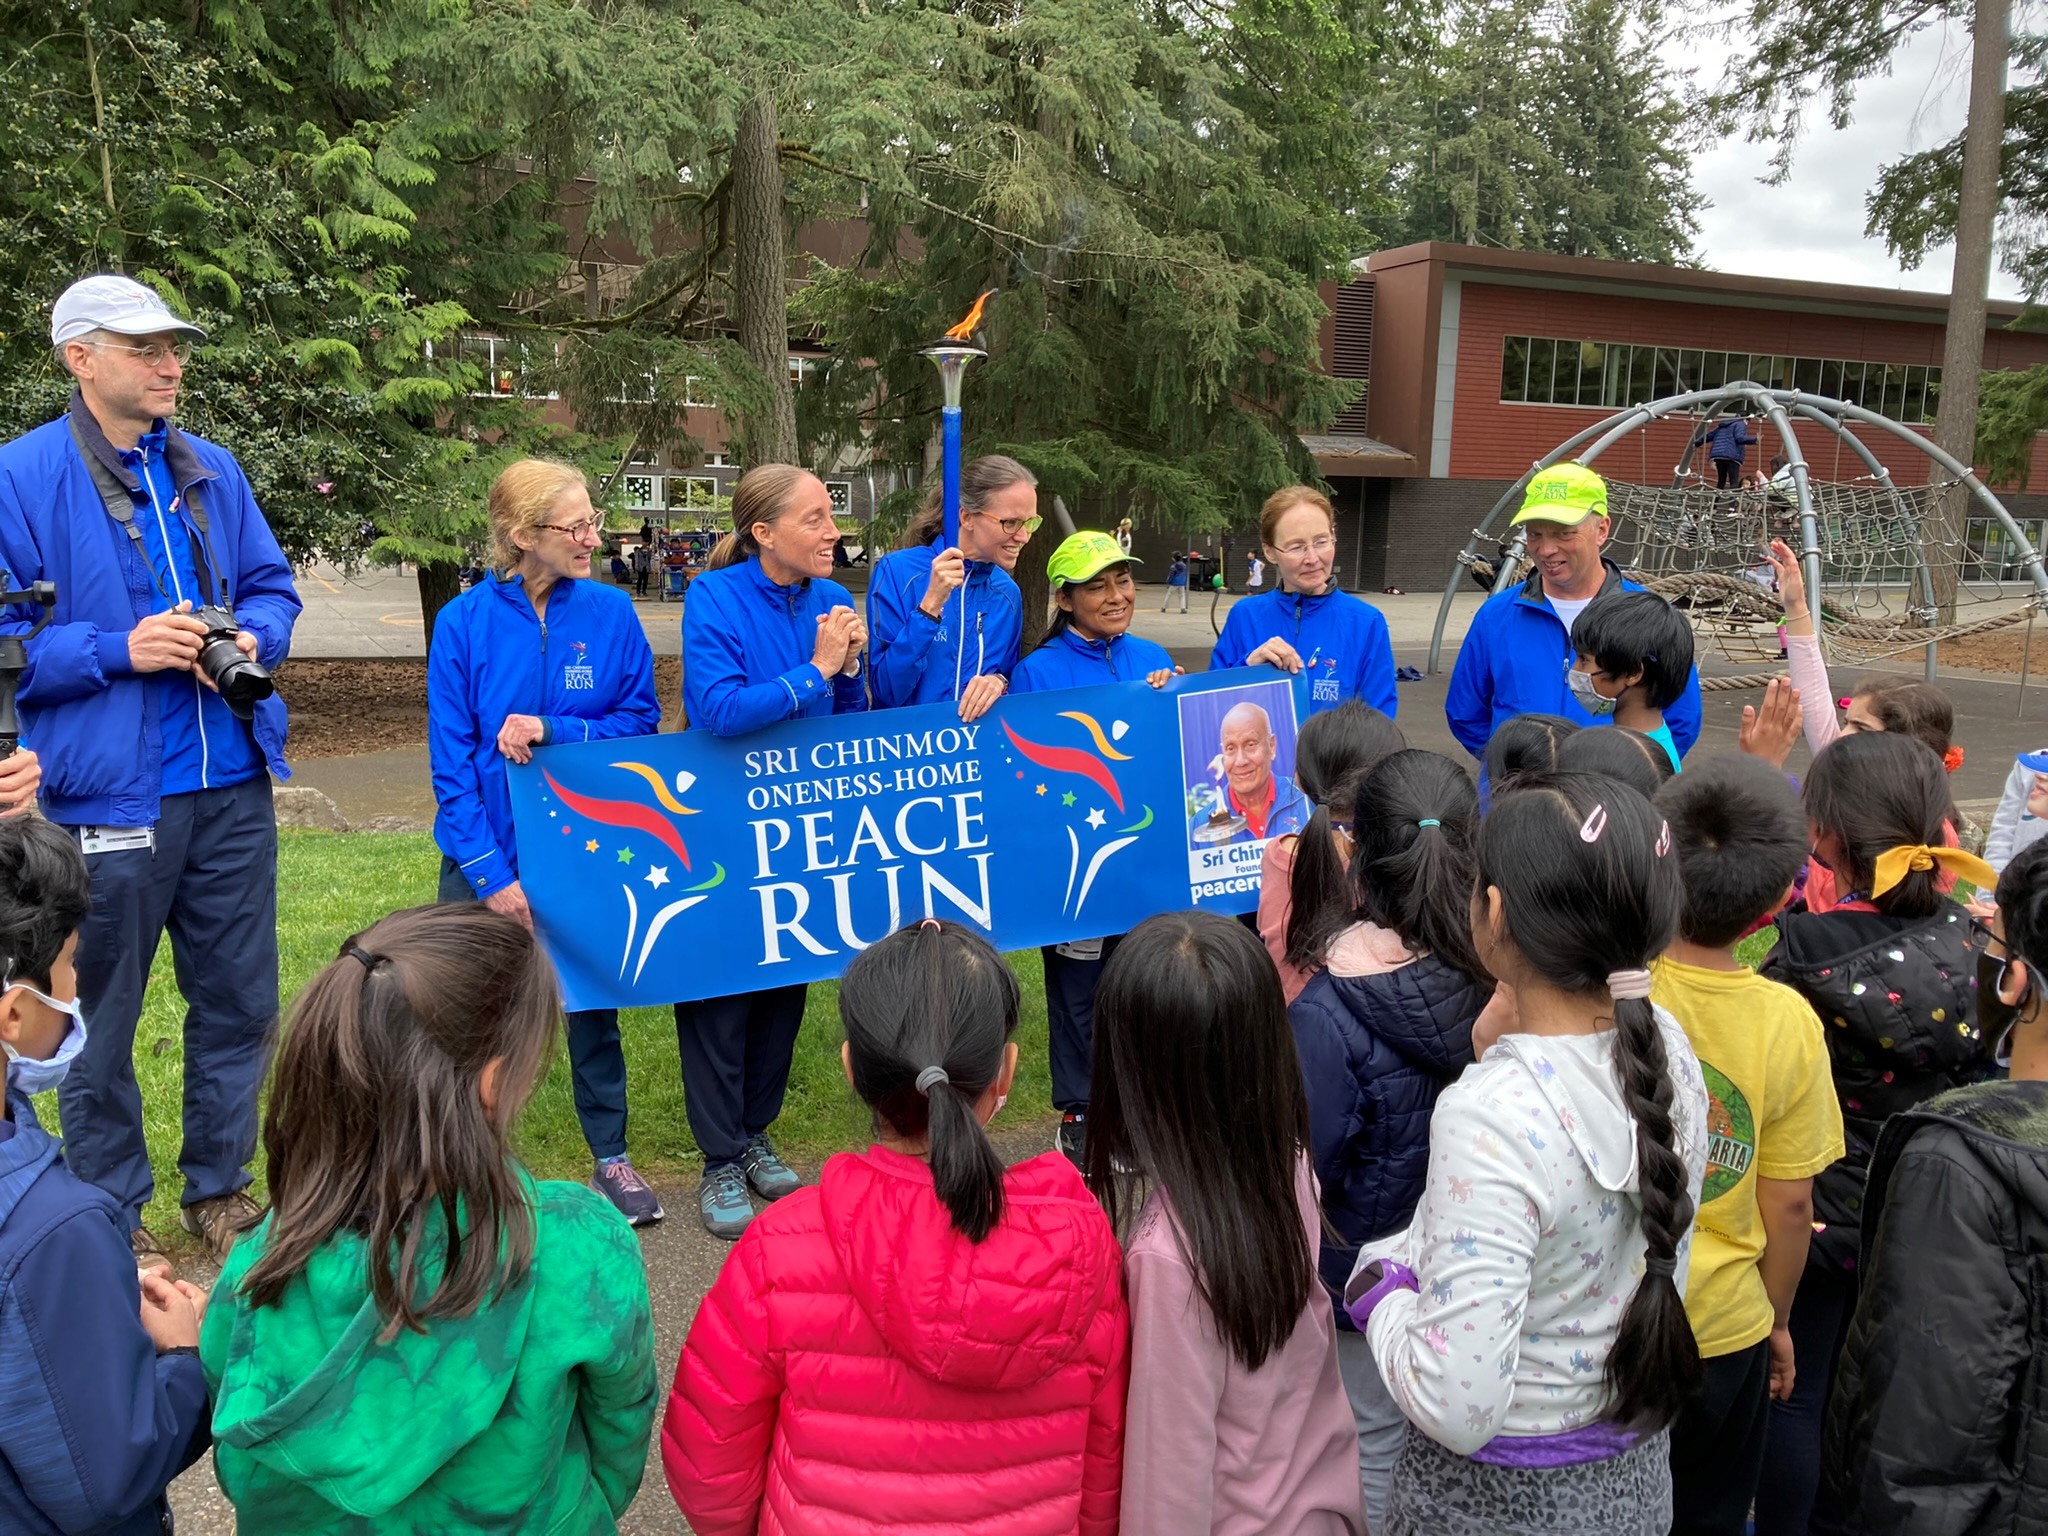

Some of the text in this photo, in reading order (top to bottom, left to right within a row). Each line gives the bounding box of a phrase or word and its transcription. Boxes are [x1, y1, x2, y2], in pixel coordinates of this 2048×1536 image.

[1544, 492, 1567, 500] RUN
[565, 673, 593, 681] PEACE
[565, 680, 594, 689] RUN
[1313, 691, 1338, 700] RUN
[744, 725, 981, 778] SRI CHINMOY
[747, 760, 982, 811] ONENESS-HOME
[747, 791, 988, 879] PEACE
[1202, 850, 1224, 868] Sri
[749, 852, 995, 966] RUN
[1707, 1135, 1748, 1172] ARTA
[1694, 1225, 1730, 1239] a.com
